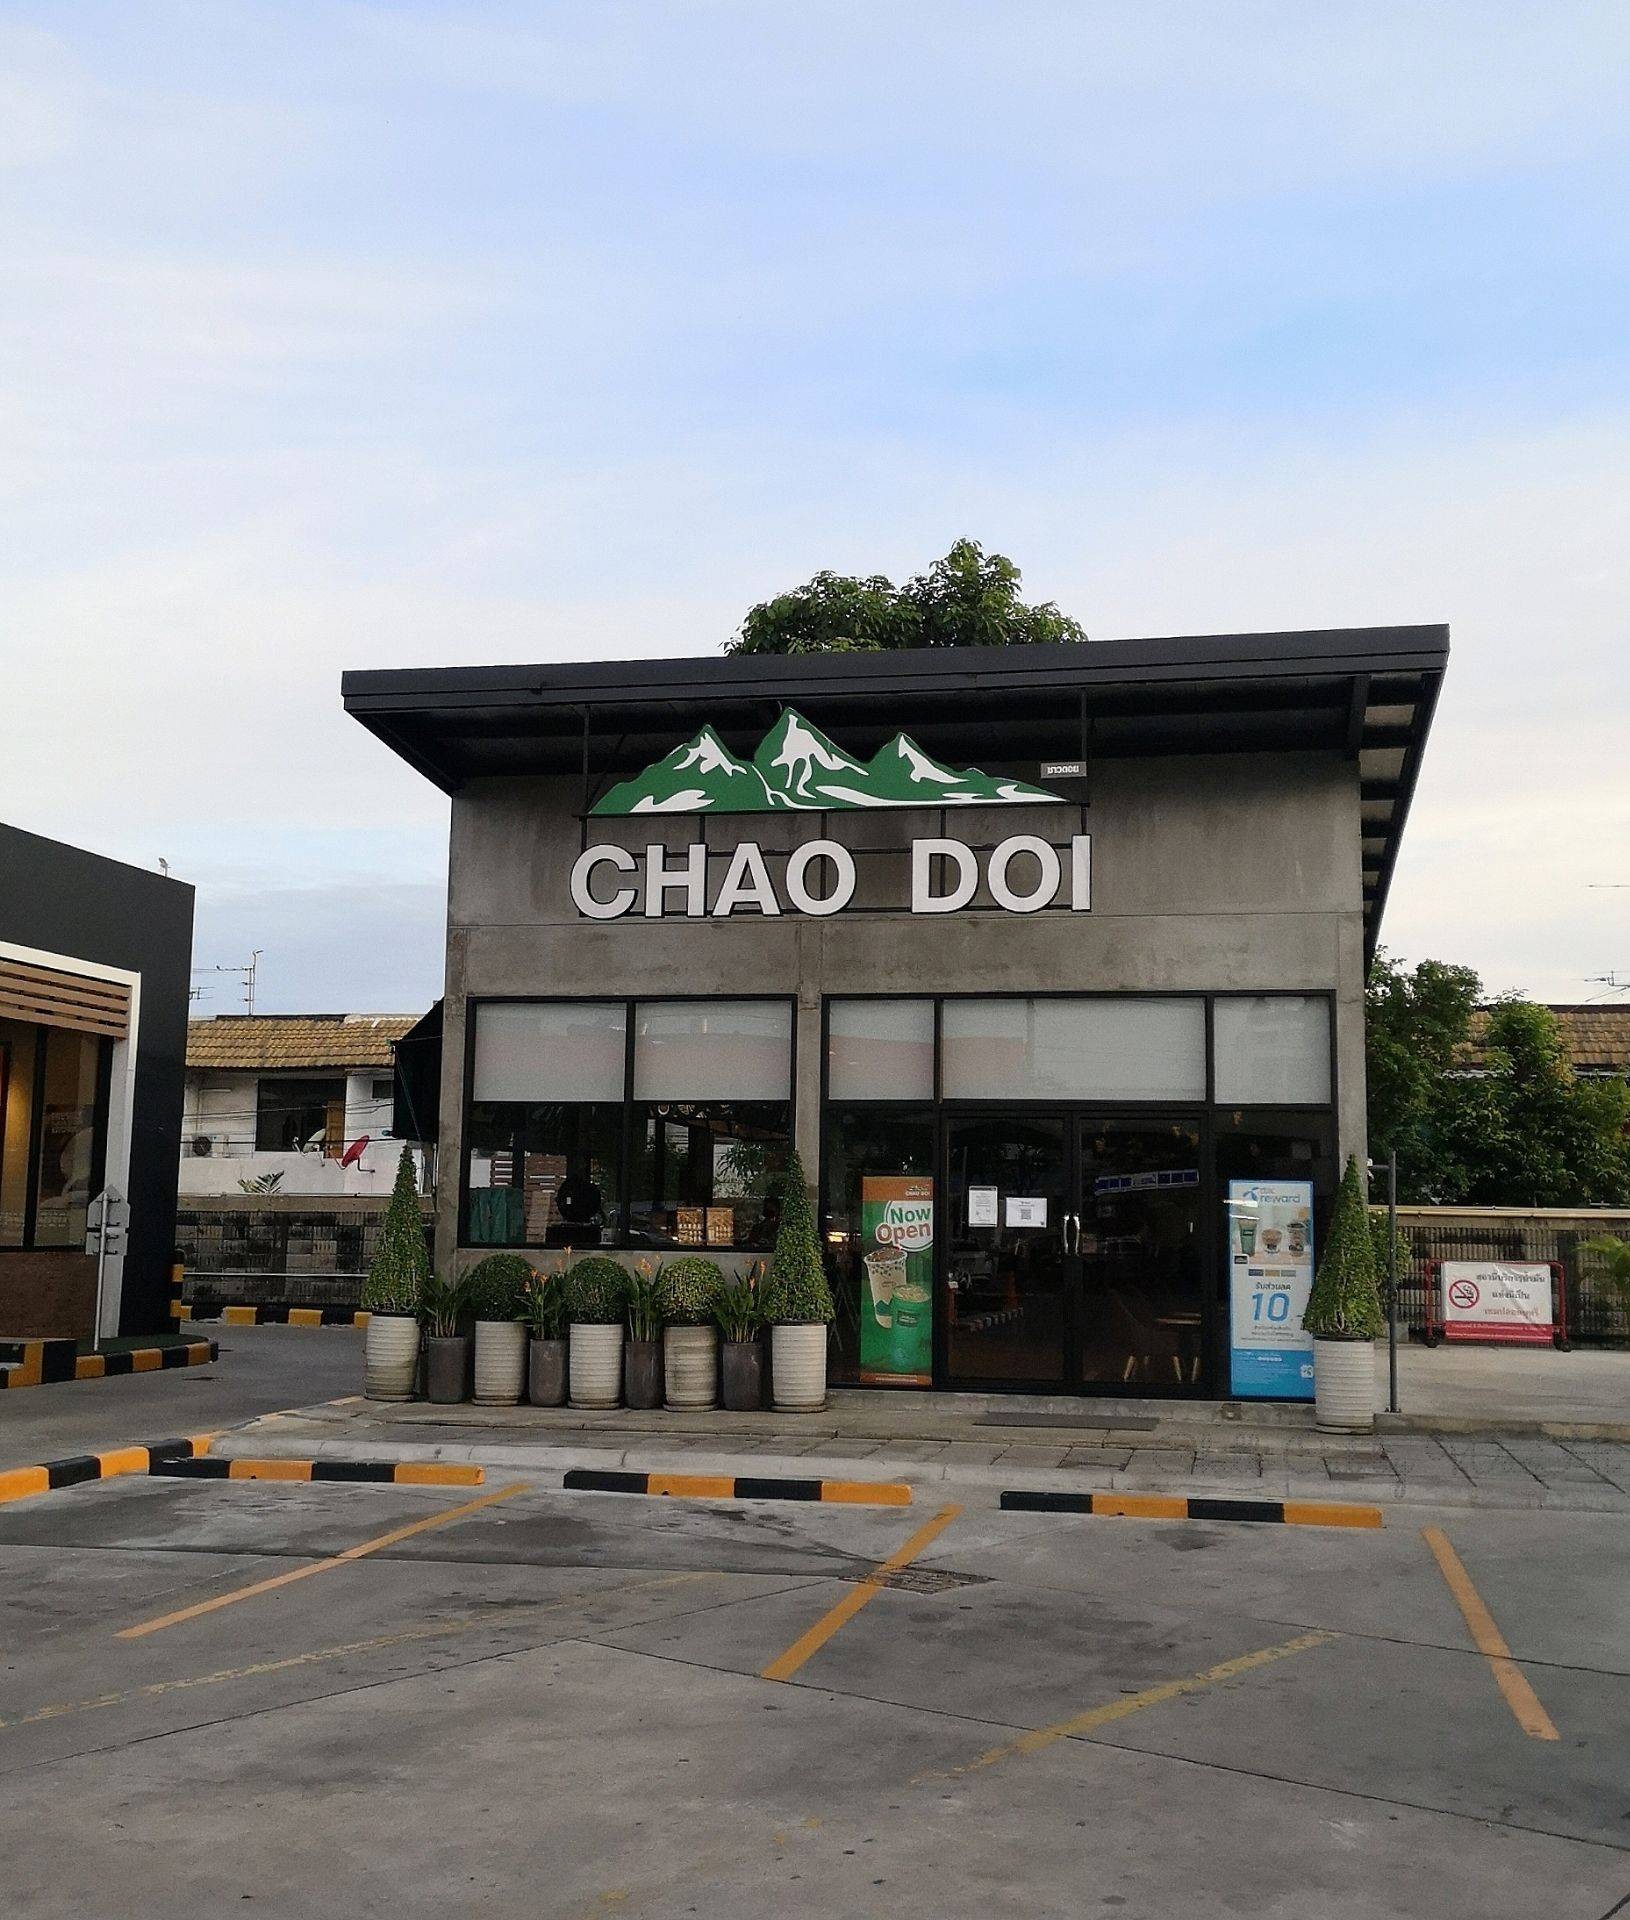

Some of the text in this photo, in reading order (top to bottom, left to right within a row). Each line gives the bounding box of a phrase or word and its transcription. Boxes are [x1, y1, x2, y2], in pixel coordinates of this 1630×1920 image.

[570, 834, 1091, 918] CHAO DOI
[890, 1207, 931, 1224] Now
[876, 1222, 931, 1244] Open
